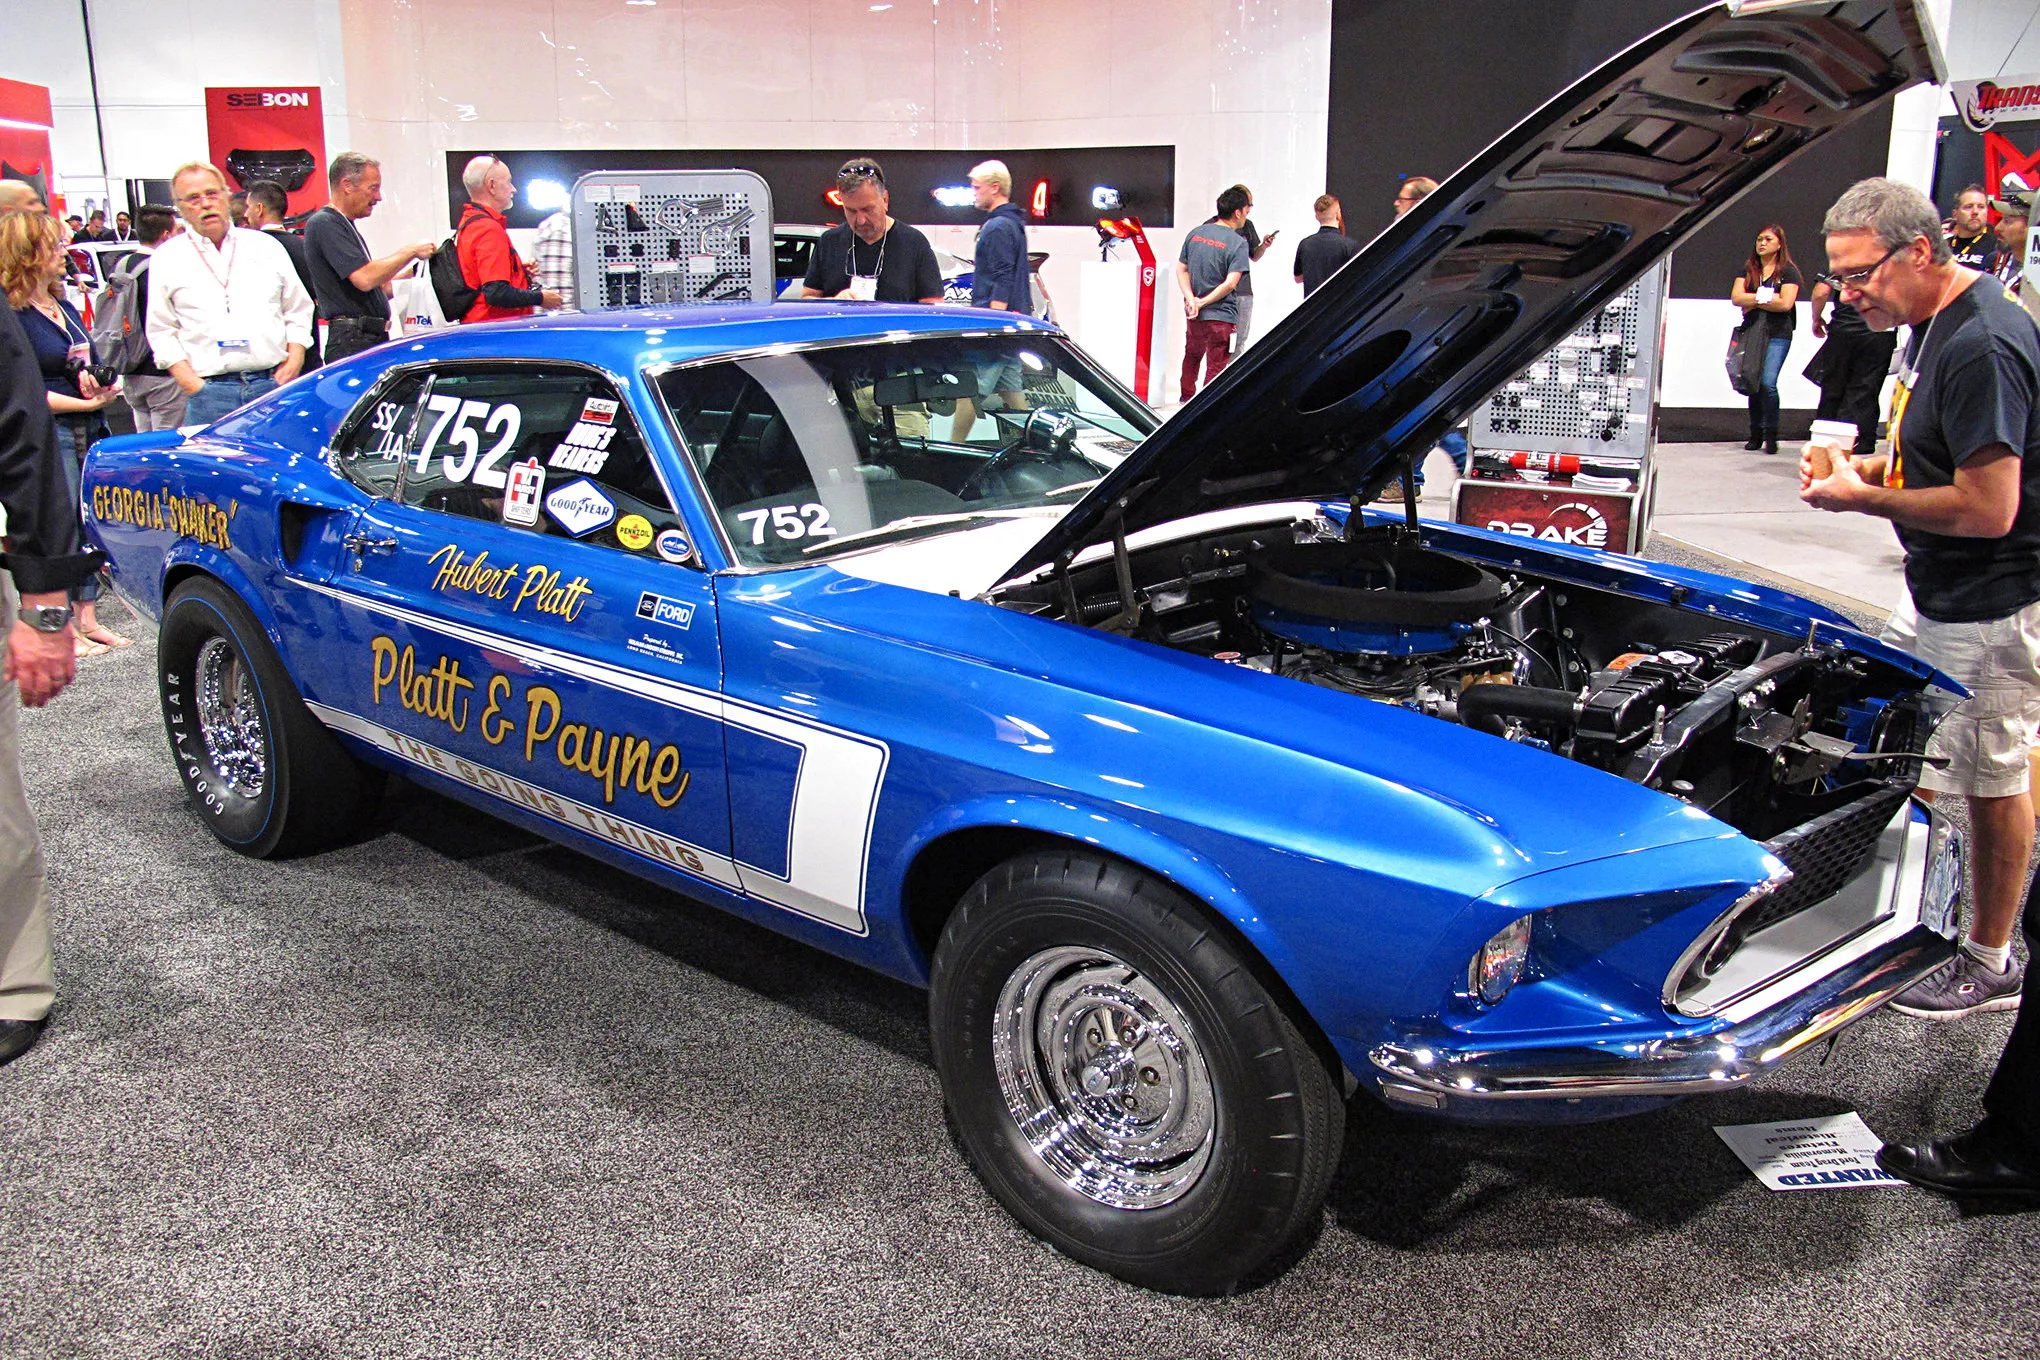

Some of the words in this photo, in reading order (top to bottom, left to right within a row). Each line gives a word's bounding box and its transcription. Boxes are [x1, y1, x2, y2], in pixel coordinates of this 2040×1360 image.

[227, 92, 309, 107] SEIBON
[415, 394, 521, 489] 752
[93, 485, 166, 531] GEORGIA
[620, 527, 650, 538] PENNZOIL
[737, 503, 838, 545] 752
[1487, 520, 1608, 547] DRAKE
[427, 543, 520, 601] Hubert
[512, 563, 594, 624] Platt
[658, 603, 689, 622] FORD
[371, 635, 475, 733] Platt
[481, 674, 516, 745] &
[526, 686, 690, 809] Payne
[385, 731, 449, 771] THE
[455, 760, 567, 819] GOING
[576, 806, 705, 873] THING
[1764, 1133, 1837, 1144] Historical
[1779, 1141, 1840, 1150] Fixtures
[1784, 1147, 1848, 1159] Memorabilia
[1839, 1156, 1861, 1166] Ford
[1815, 1158, 1840, 1167] Drag
[1778, 1168, 1895, 1185] WANTED
